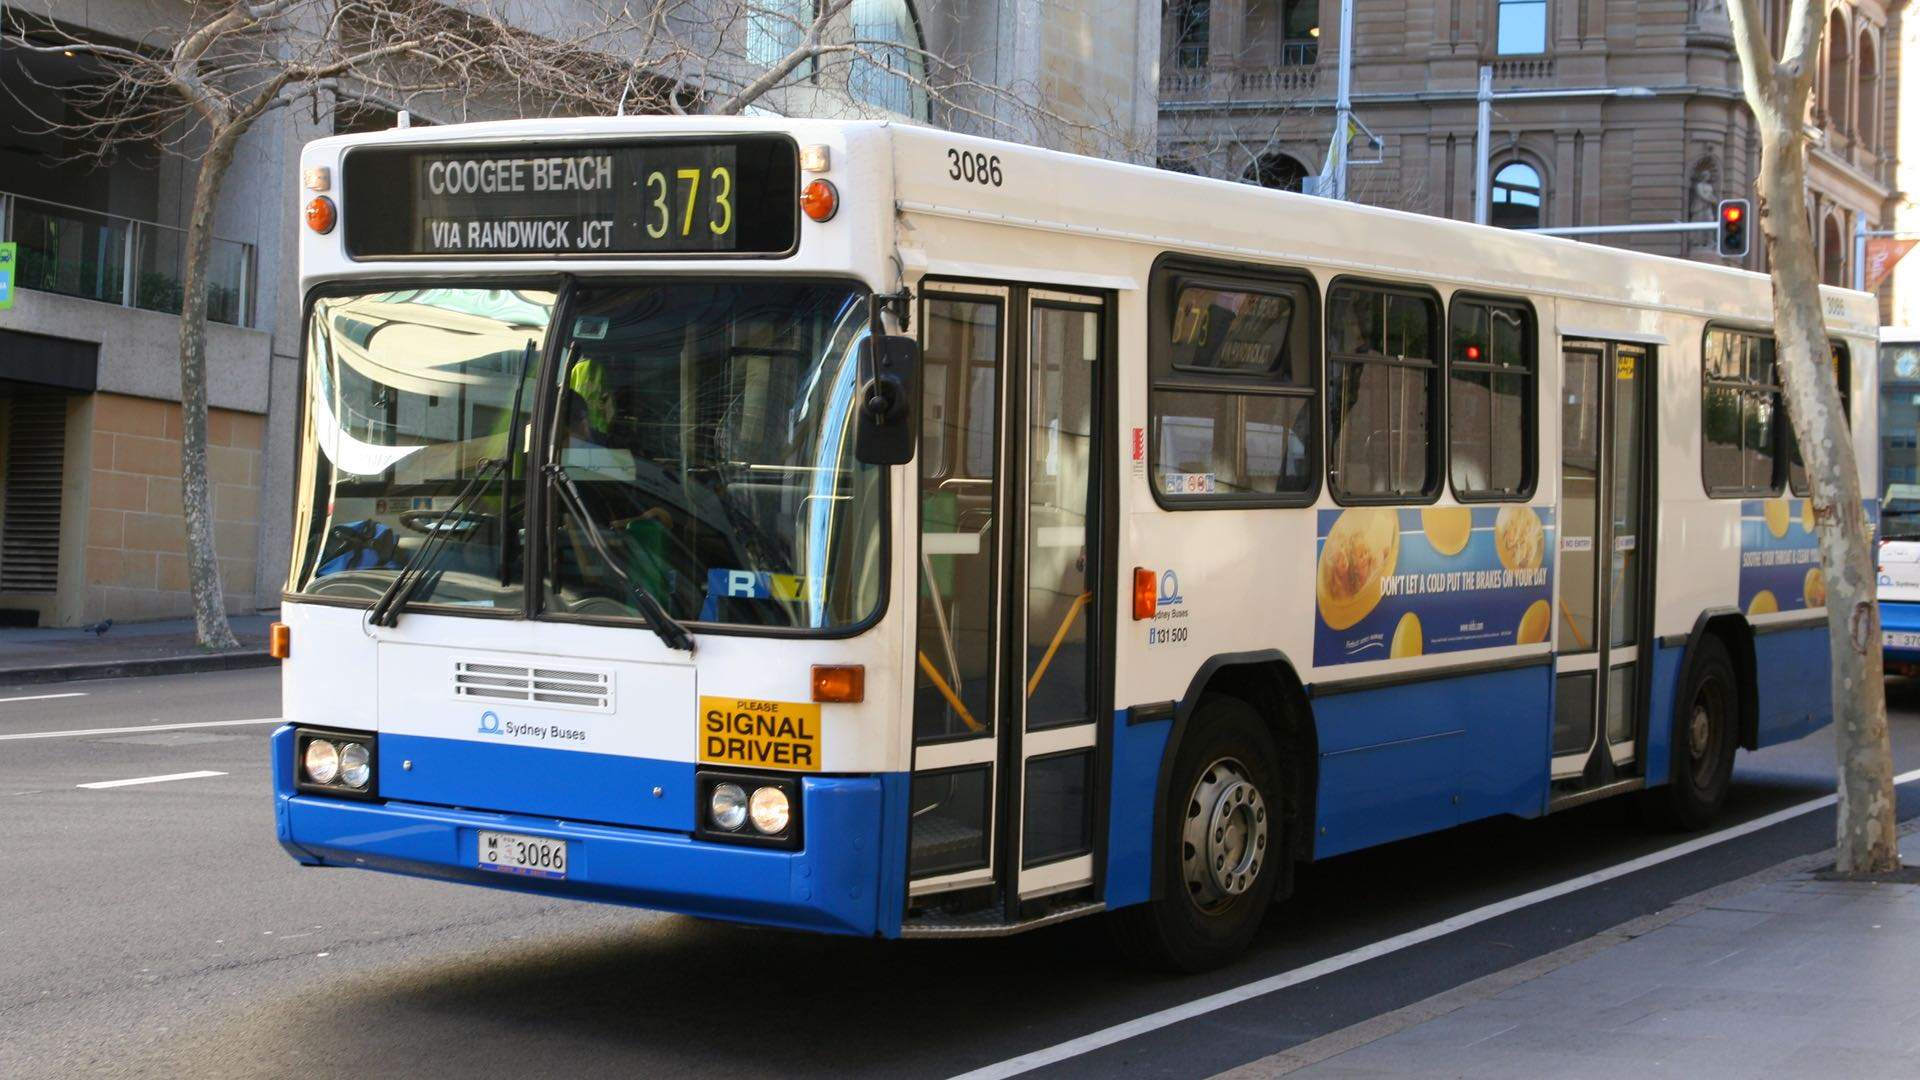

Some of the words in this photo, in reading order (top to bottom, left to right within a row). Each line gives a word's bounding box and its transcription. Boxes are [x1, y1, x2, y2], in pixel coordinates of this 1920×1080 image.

[429, 159, 525, 195] COOGEE
[533, 156, 612, 192] BEACH
[948, 148, 1003, 187] 3086
[646, 167, 732, 239] 373
[431, 221, 462, 249] VIA
[468, 221, 570, 249] RANDWICK
[576, 220, 614, 249] JCT
[728, 569, 756, 598] R
[1380, 574, 1405, 596] DON'T
[1406, 573, 1419, 595] LET
[1419, 573, 1426, 594] A
[1426, 572, 1446, 594] COLD
[1446, 571, 1460, 593] PUT
[1462, 570, 1475, 591] THE
[1475, 569, 1502, 591] BRAKES
[1503, 568, 1513, 588] ON
[1513, 567, 1534, 587] YOUR
[1534, 566, 1548, 586] DAY
[1157, 628, 1170, 643] 131
[1171, 626, 1188, 642] 500
[737, 700, 779, 713] PLEASE
[506, 721, 548, 740] Sydney
[550, 725, 586, 741] Buses
[706, 710, 814, 740] SIGNAL
[707, 736, 813, 766] DRIVER
[487, 837, 498, 849] M
[517, 842, 563, 869] 3086
